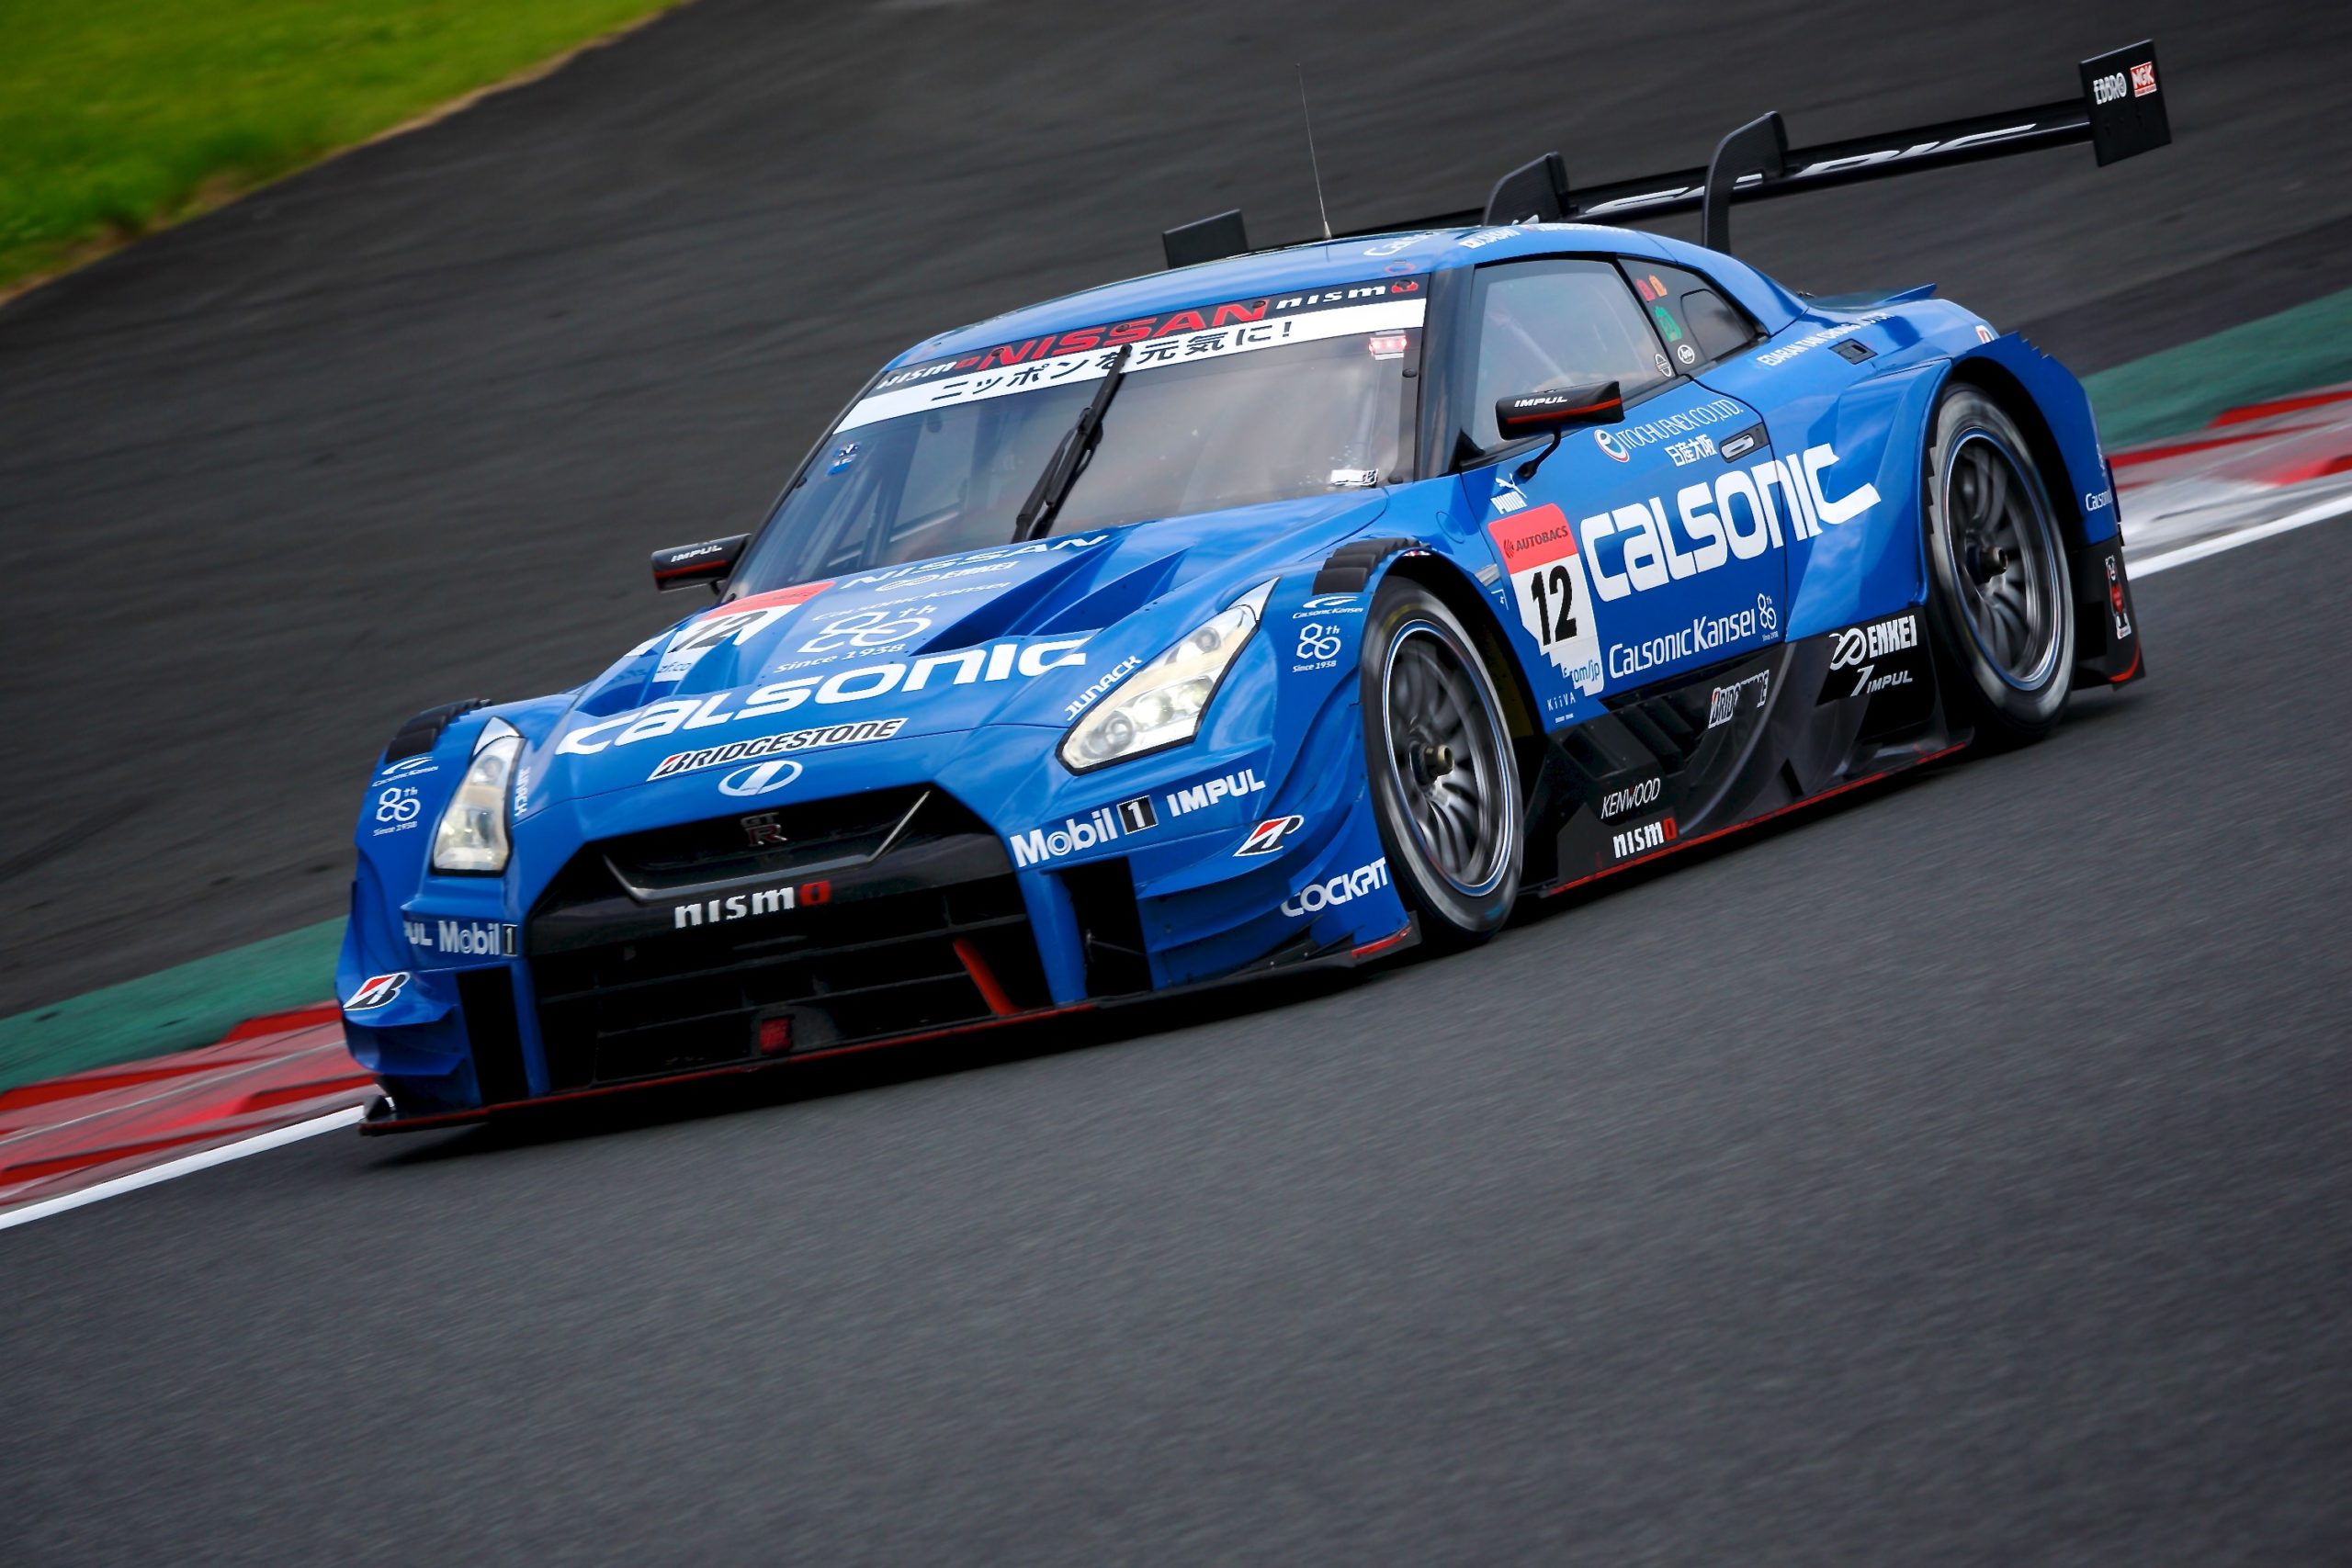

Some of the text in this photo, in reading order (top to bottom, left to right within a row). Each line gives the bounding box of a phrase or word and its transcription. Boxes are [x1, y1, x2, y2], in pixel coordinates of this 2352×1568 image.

[2132, 64, 2154, 89] NGK
[976, 299, 1270, 371] NISSAN
[1276, 279, 1419, 310] nismo
[1514, 396, 1567, 408] IMPUL
[1615, 420, 1669, 449] ITOCHU
[671, 545, 722, 562] IMPUL
[1516, 525, 1568, 551] AUTOBACS
[841, 536, 1109, 589] NISSAN
[1531, 565, 1577, 646] 12
[1868, 615, 1917, 658] ENKEI
[773, 643, 906, 673] Since 1938
[1064, 655, 1142, 721] JUNACK
[1868, 671, 1913, 694] IMPUL
[650, 718, 905, 779] BRIDGESTONE
[1167, 769, 1265, 818] IMPUL
[1600, 777, 1661, 819] KENWOOD
[1010, 798, 1152, 868] Mobil 1
[1613, 817, 1677, 858] nismo
[674, 880, 831, 929] nismo
[1281, 857, 1388, 917] COCKPIT
[438, 920, 500, 955] Mobil
